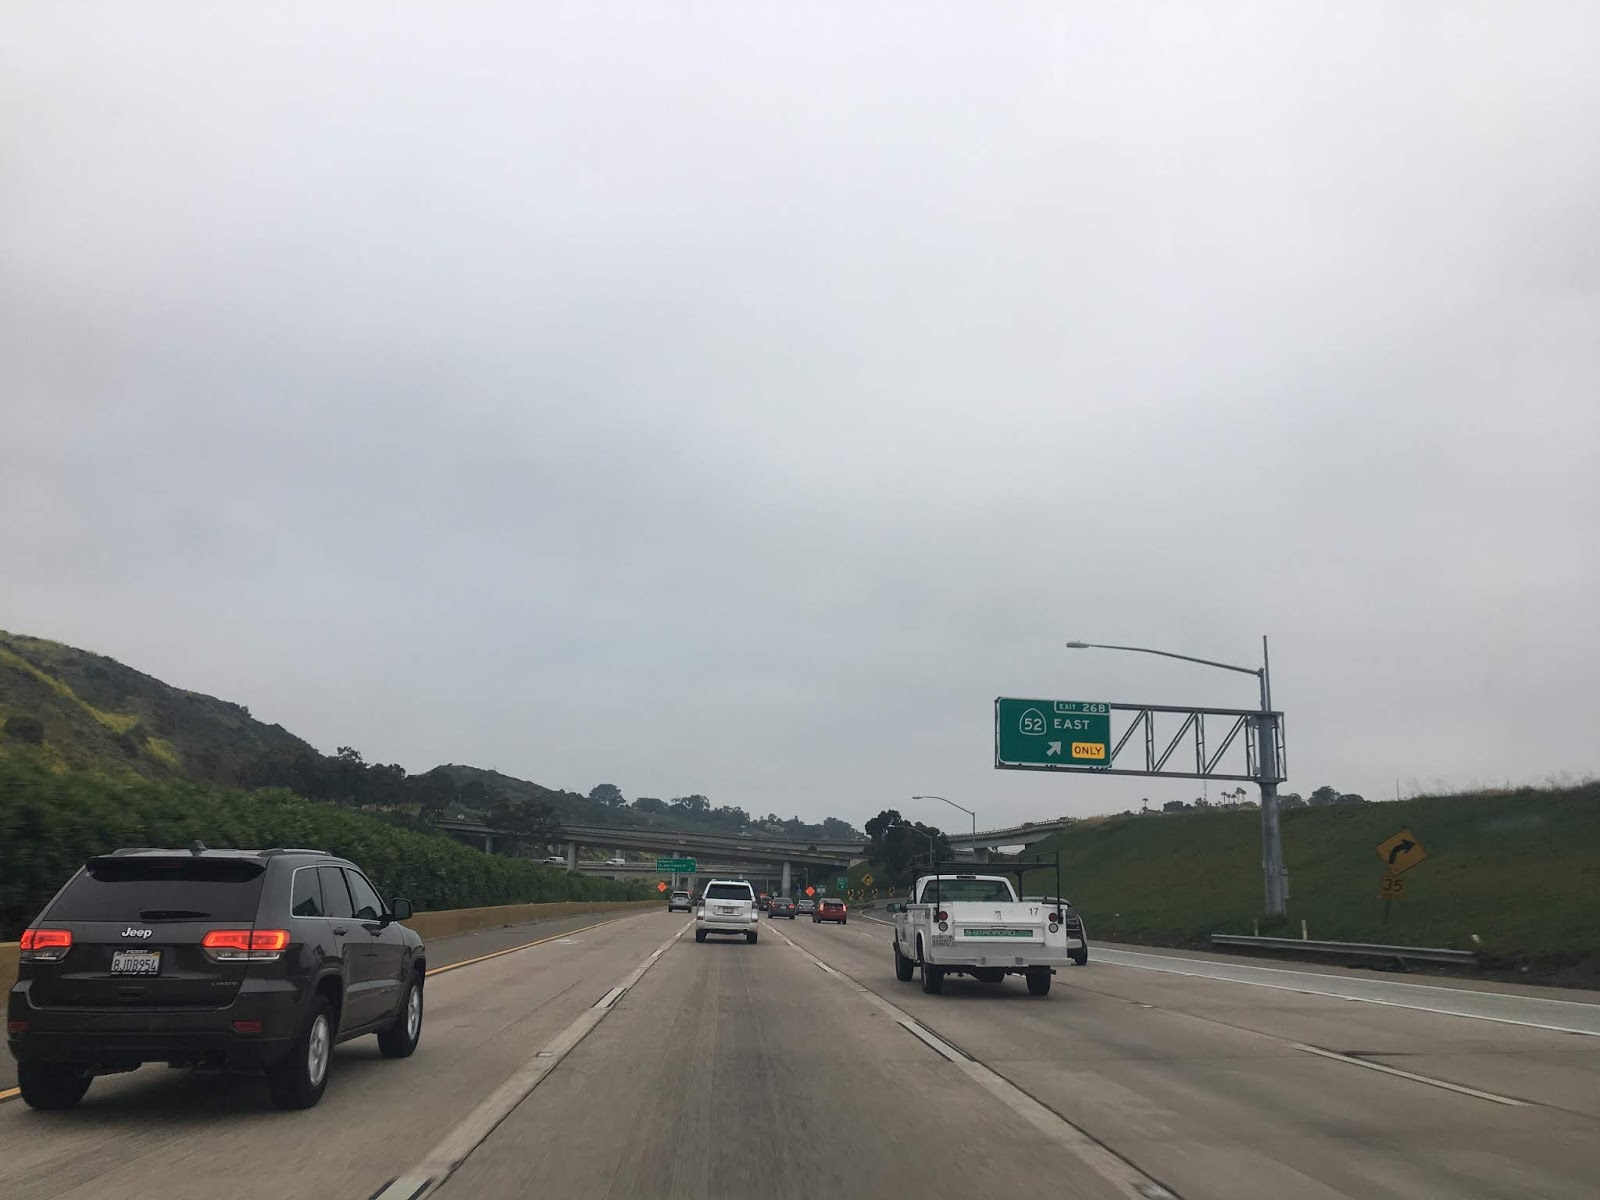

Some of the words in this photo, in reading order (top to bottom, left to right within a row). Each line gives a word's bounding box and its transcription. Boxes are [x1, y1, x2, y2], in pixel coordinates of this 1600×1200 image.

[1082, 703, 1106, 713] 26B
[1024, 718, 1042, 731] 52
[1054, 718, 1090, 730] EAST
[1074, 745, 1102, 755] ONLY
[1383, 878, 1403, 893] 35
[1029, 907, 1039, 916] 17
[121, 927, 152, 939] Jeep
